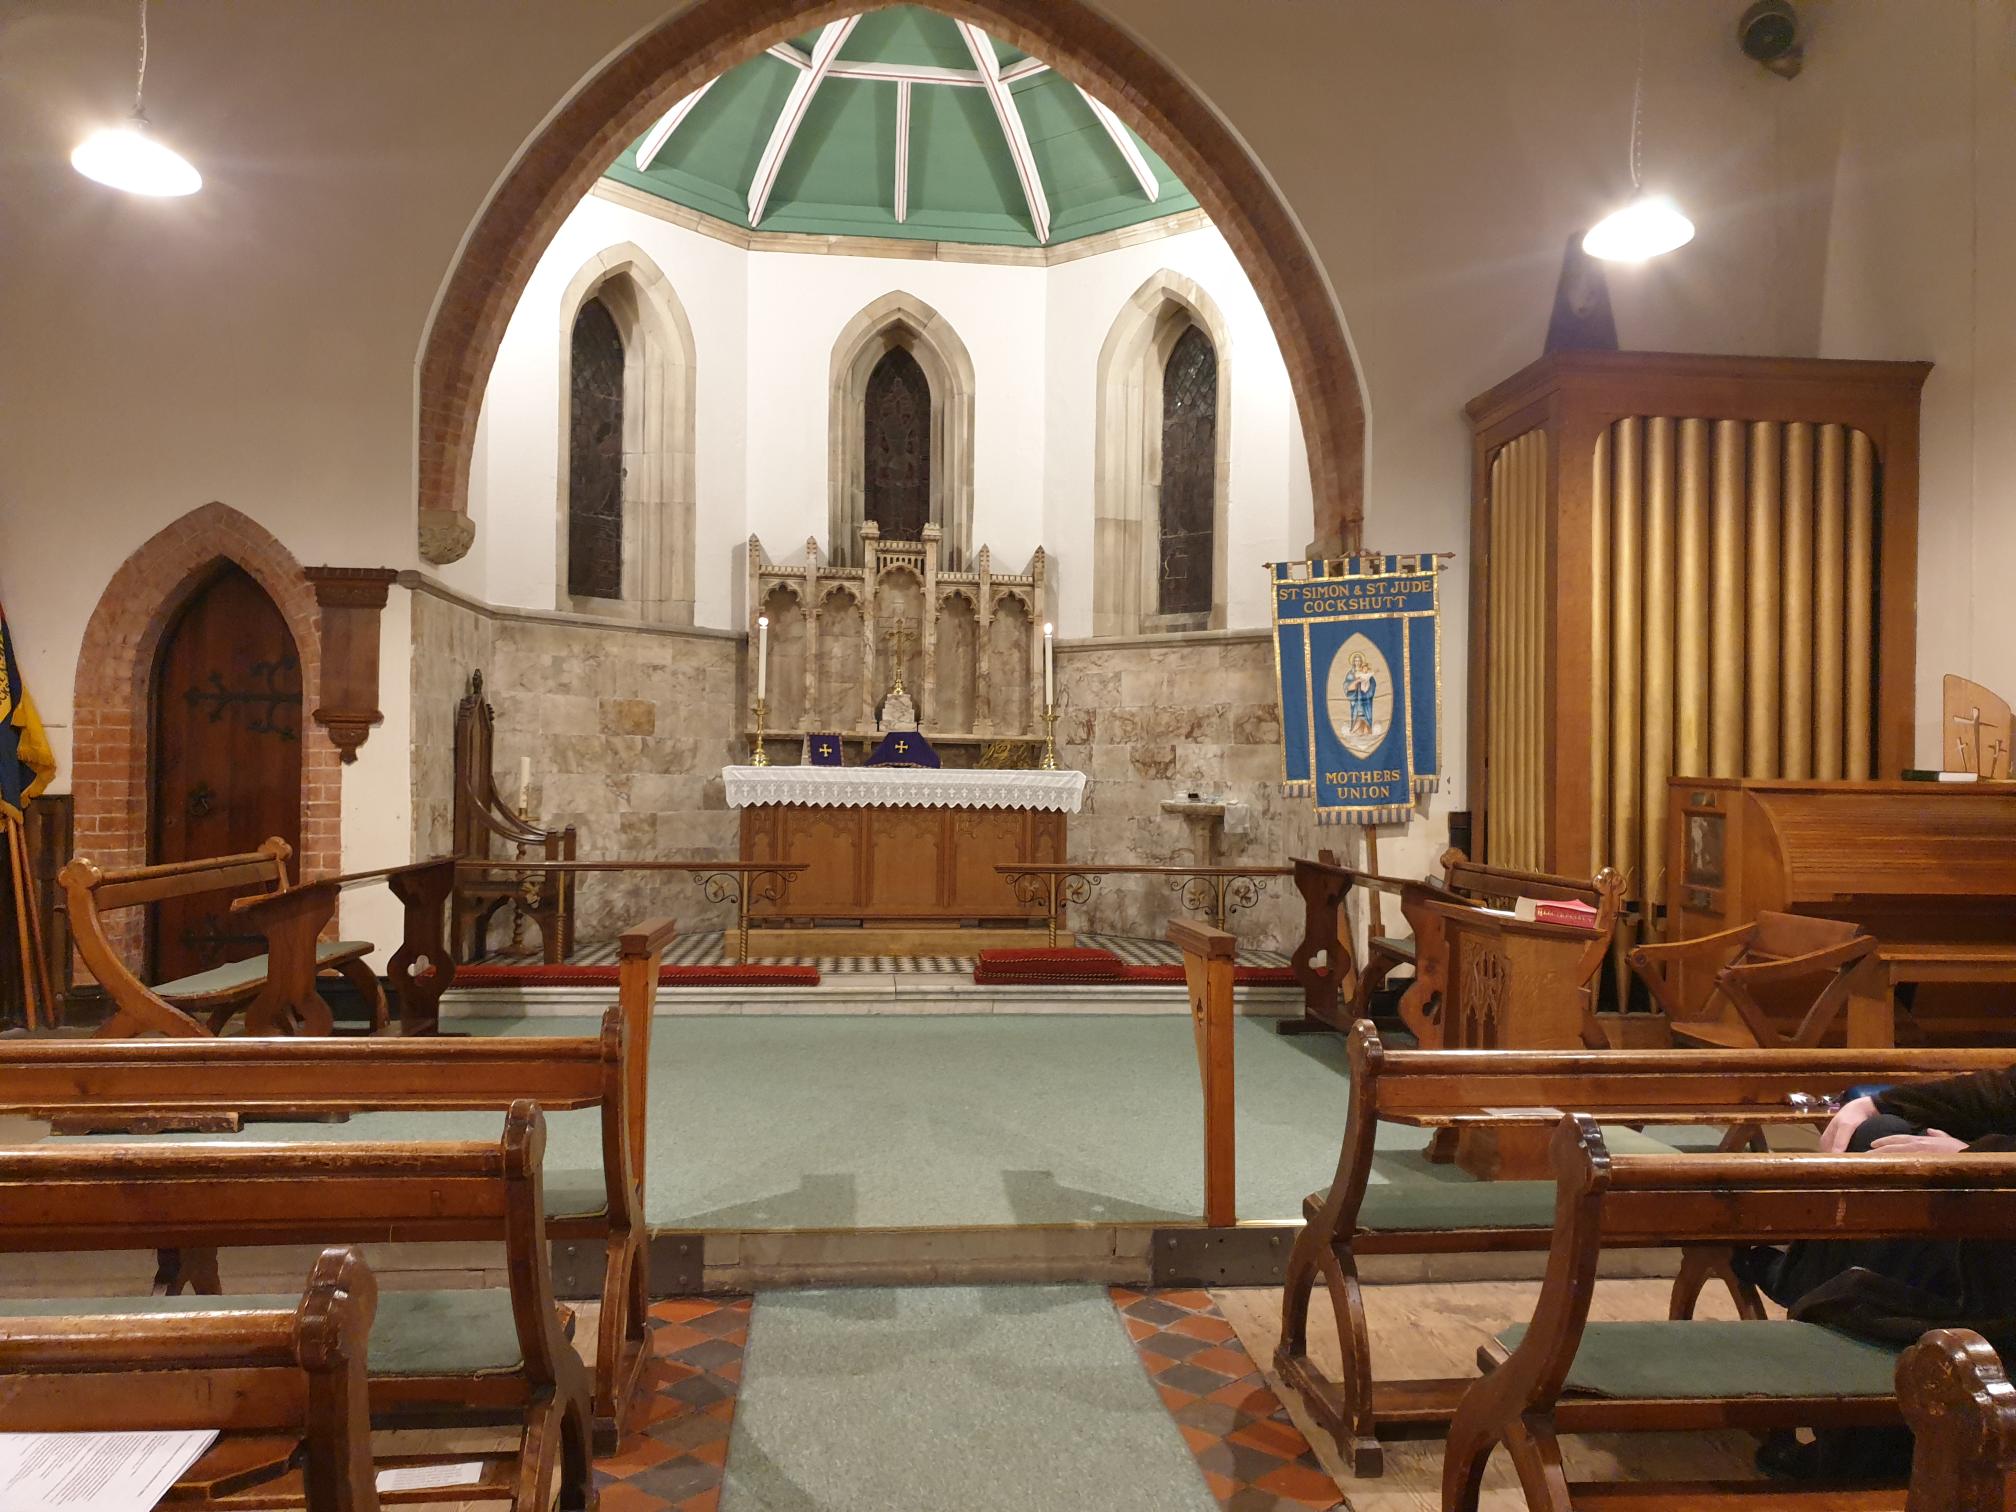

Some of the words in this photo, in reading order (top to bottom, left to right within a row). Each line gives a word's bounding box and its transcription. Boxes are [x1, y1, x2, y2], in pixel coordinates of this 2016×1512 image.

[1279, 588, 1299, 600] ST
[1302, 584, 1349, 599] SIMON
[1354, 585, 1362, 595] &
[1366, 582, 1387, 595] ST
[1390, 580, 1431, 593] JUDE
[1303, 595, 1406, 613] COCKSHUTT
[1326, 770, 1400, 784] MOTHERS
[1337, 786, 1389, 798] UNION
